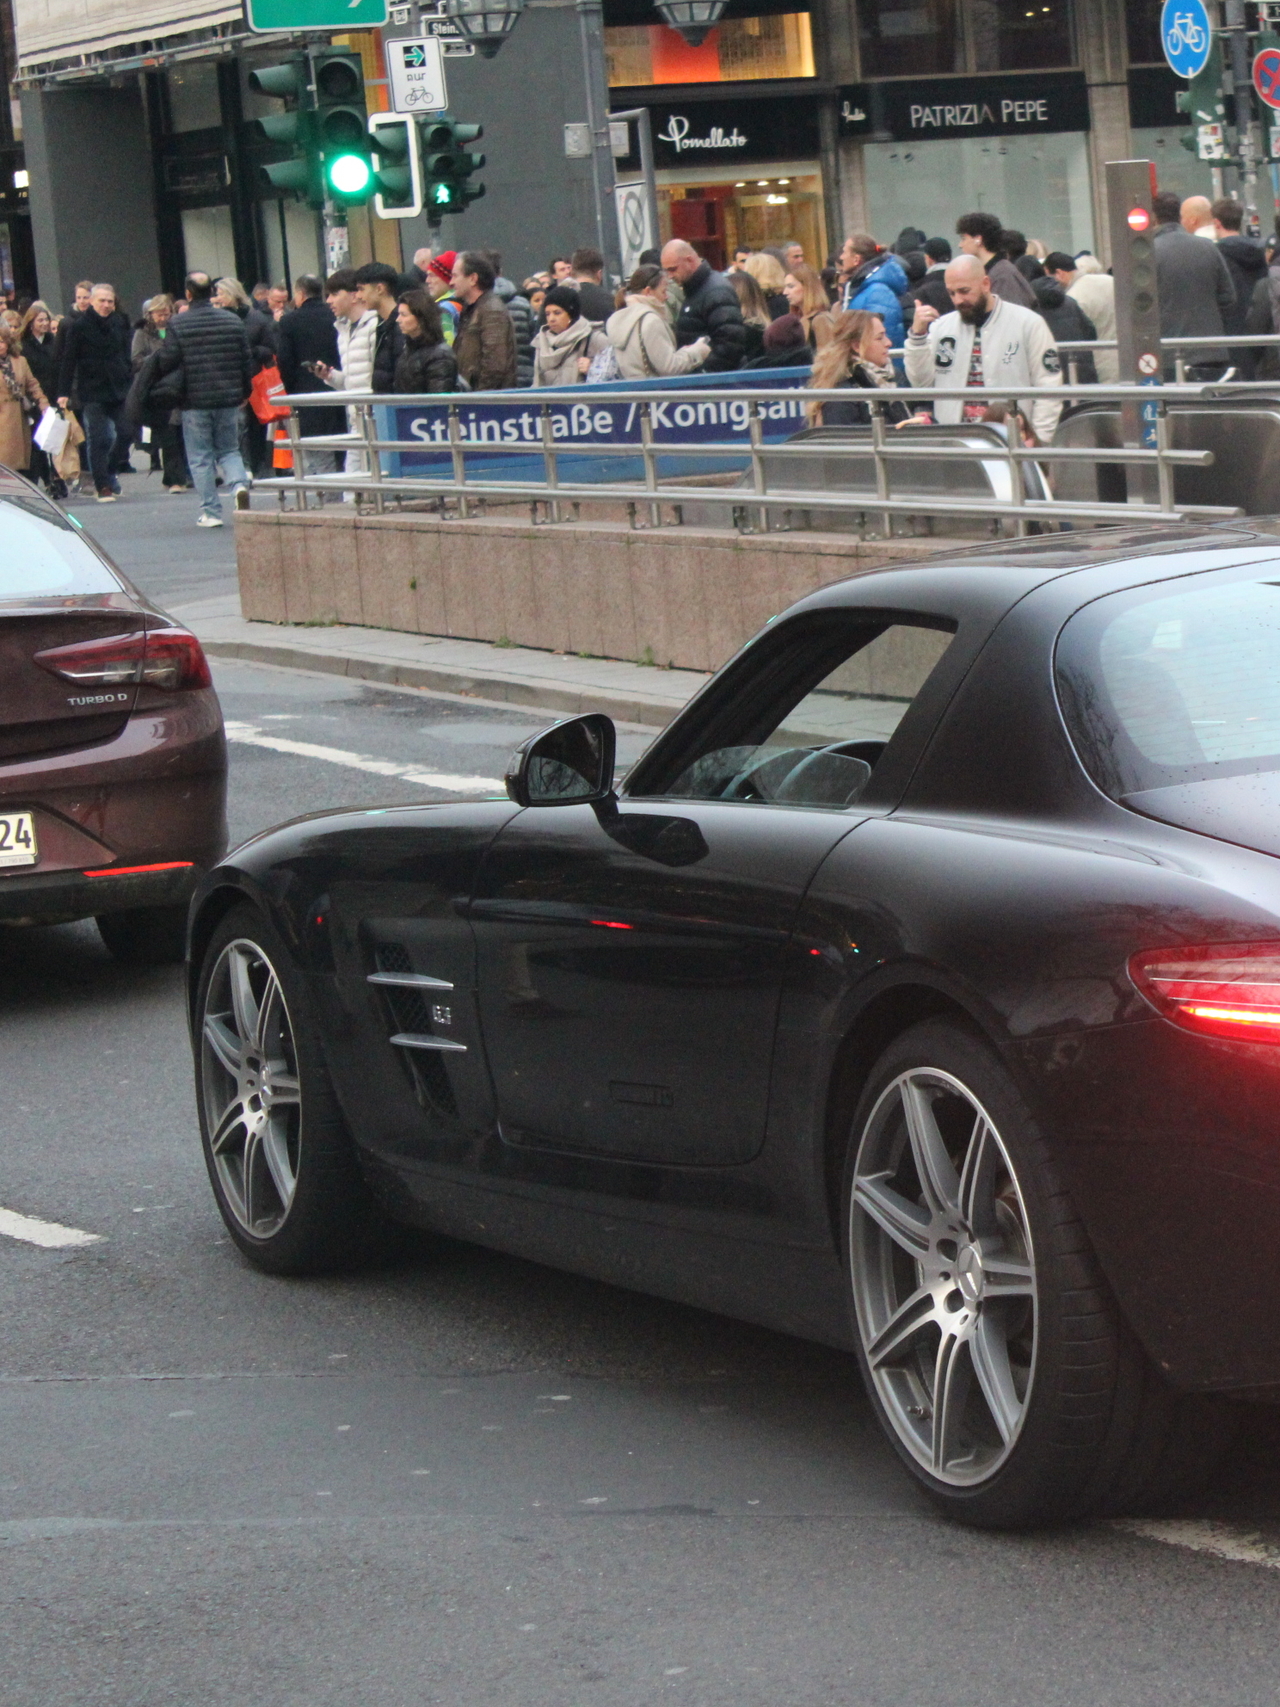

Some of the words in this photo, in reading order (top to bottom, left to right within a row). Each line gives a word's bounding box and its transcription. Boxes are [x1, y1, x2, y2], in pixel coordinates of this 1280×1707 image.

[406, 72, 426, 82] nur
[911, 104, 995, 128] PATRIZIA
[1001, 100, 1049, 124] PEPE
[658, 115, 748, 153] Pomellato
[67, 694, 115, 706] TURBO
[117, 693, 128, 701] D
[0, 818, 31, 851] 24
